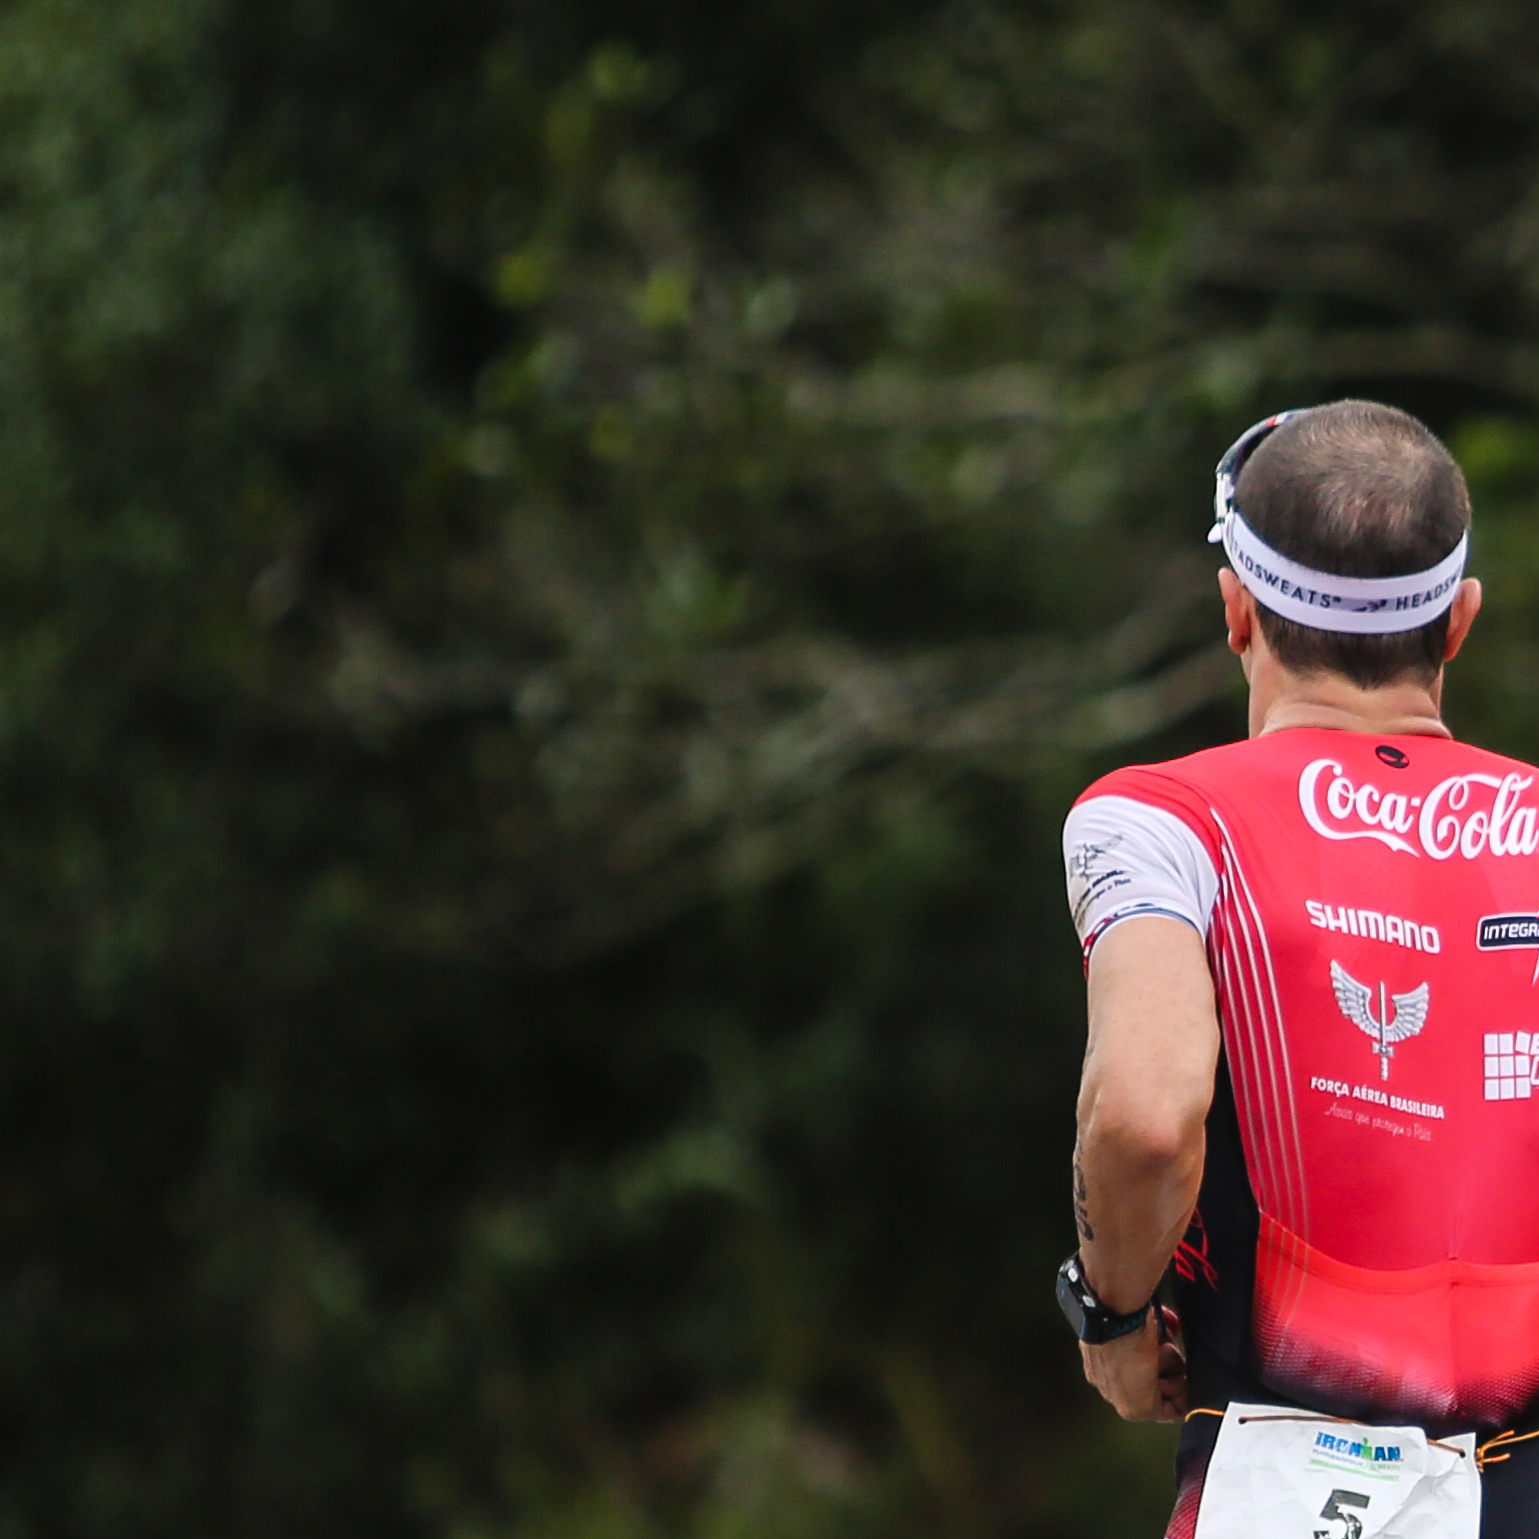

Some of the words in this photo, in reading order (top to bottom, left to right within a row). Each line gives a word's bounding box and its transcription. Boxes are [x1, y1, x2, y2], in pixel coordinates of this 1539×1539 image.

[1305, 899, 1442, 954] SHIMANO
[1310, 1076, 1350, 1098] FORÇA
[1352, 1084, 1389, 1106] AÉREA
[1389, 1095, 1445, 1119] BRASILEIRA
[1315, 1431, 1401, 1462] IRONMAN
